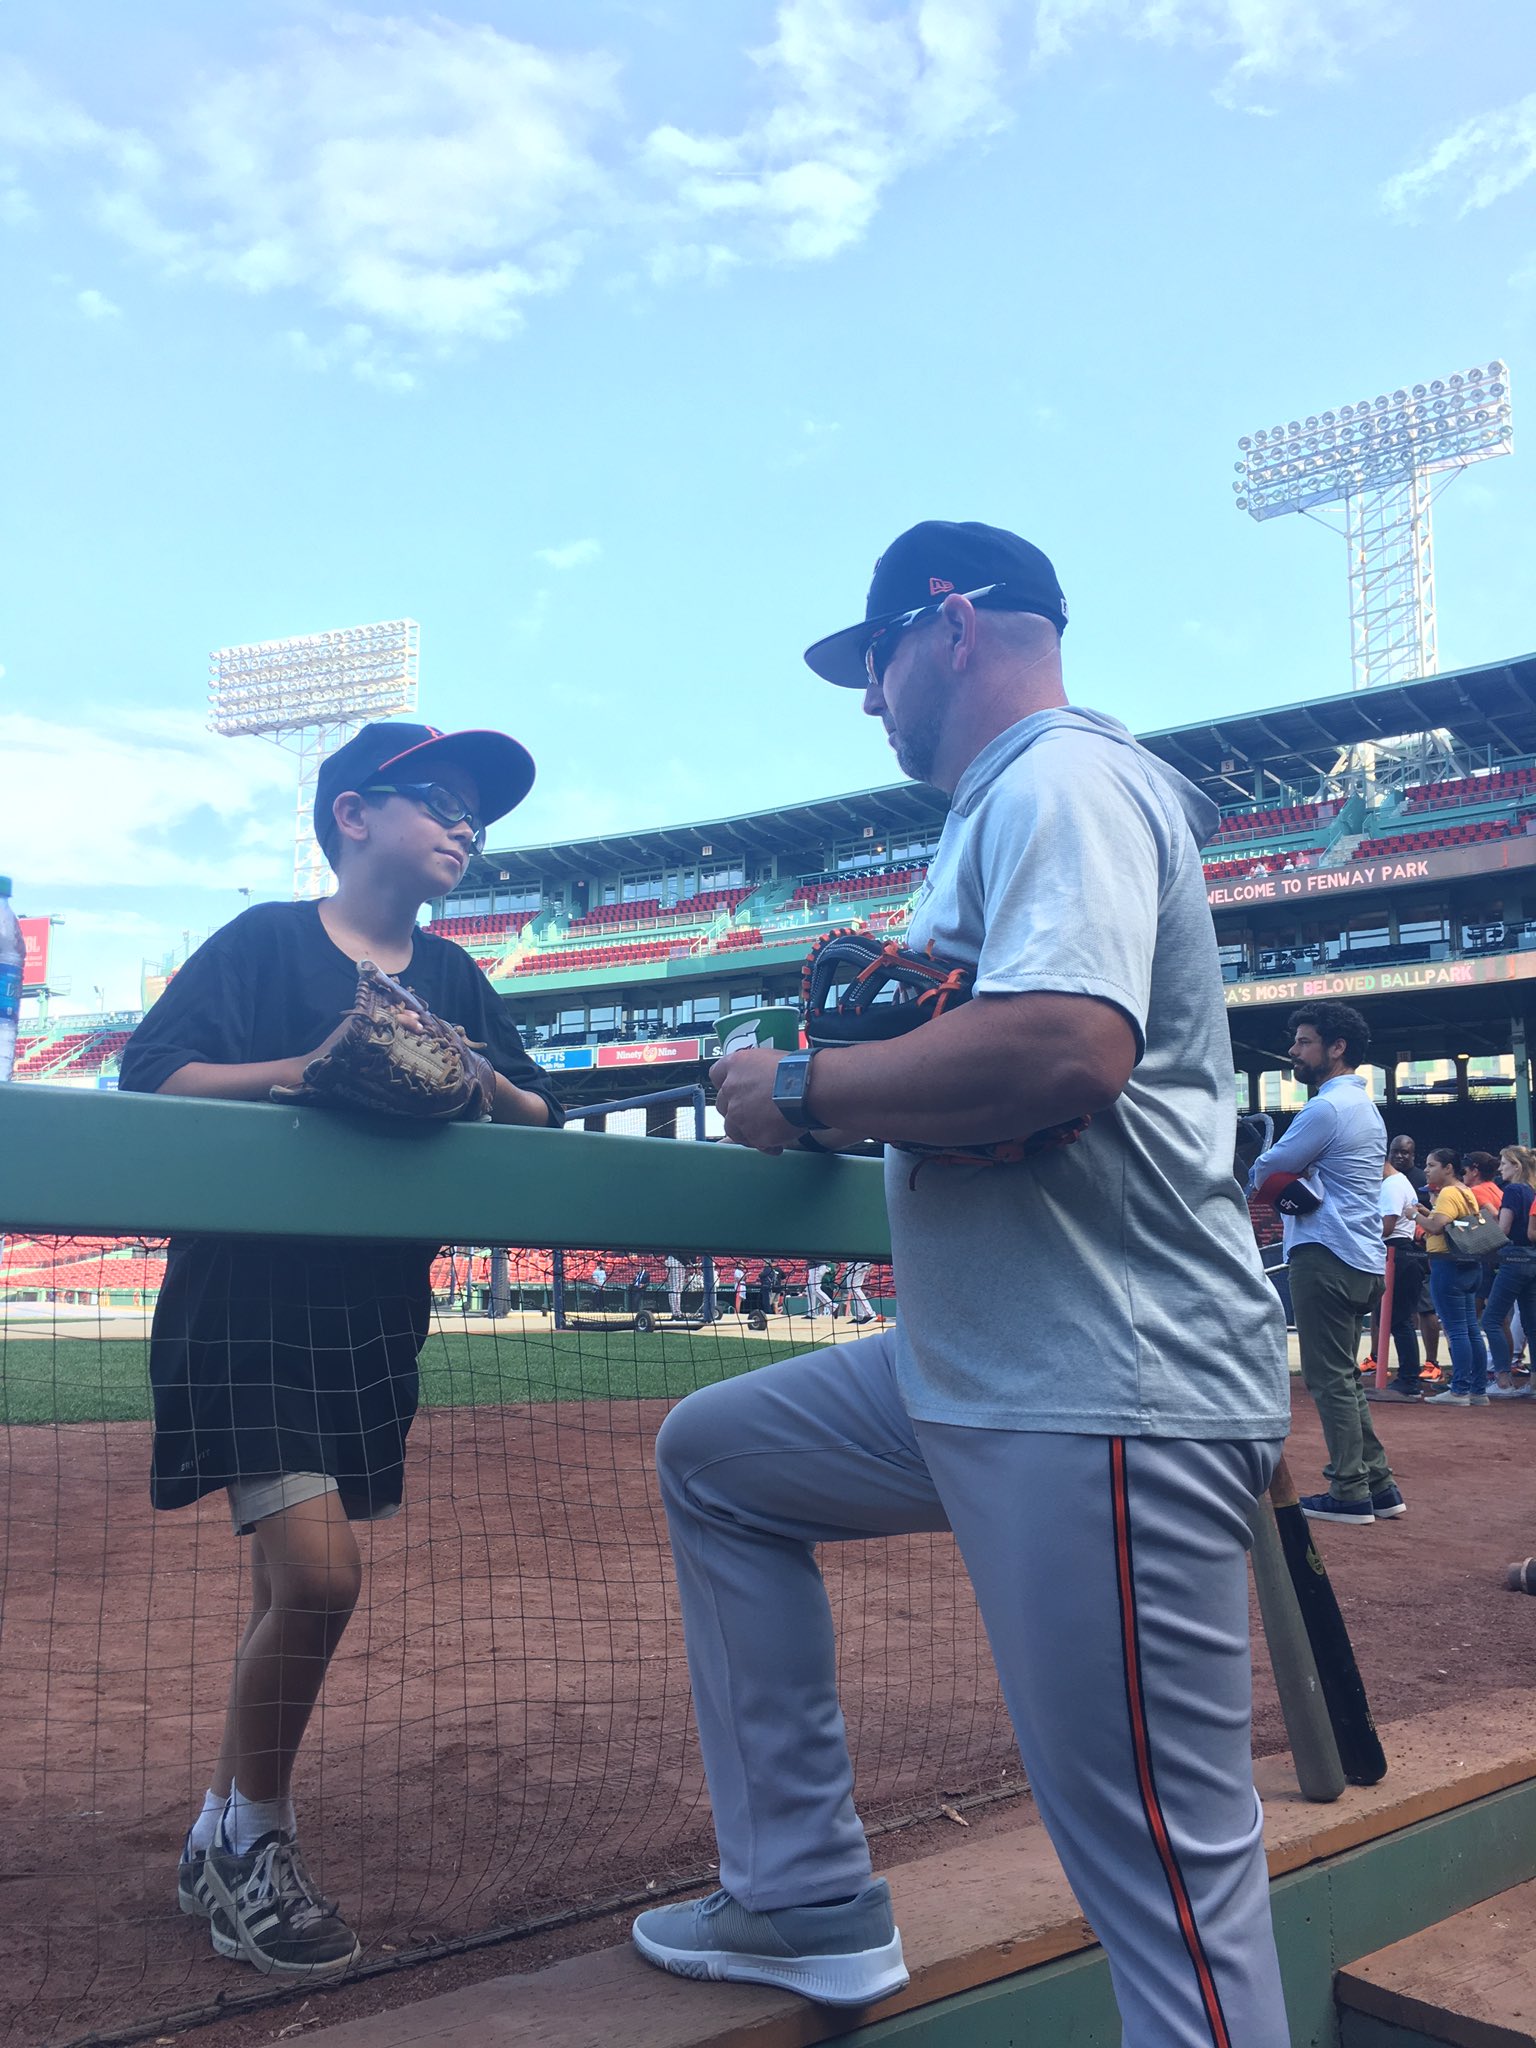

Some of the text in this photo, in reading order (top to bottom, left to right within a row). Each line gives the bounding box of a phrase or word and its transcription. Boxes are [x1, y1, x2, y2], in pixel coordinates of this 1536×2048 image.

[1207, 860, 1429, 905] WELCOME TO FENWAY PARK
[1224, 965, 1473, 1003] A'S MOST BELOVED BALLPARK
[536, 1051, 566, 1063] TUFTS
[616, 1050, 643, 1060] Ninety
[658, 1047, 677, 1057] Nine
